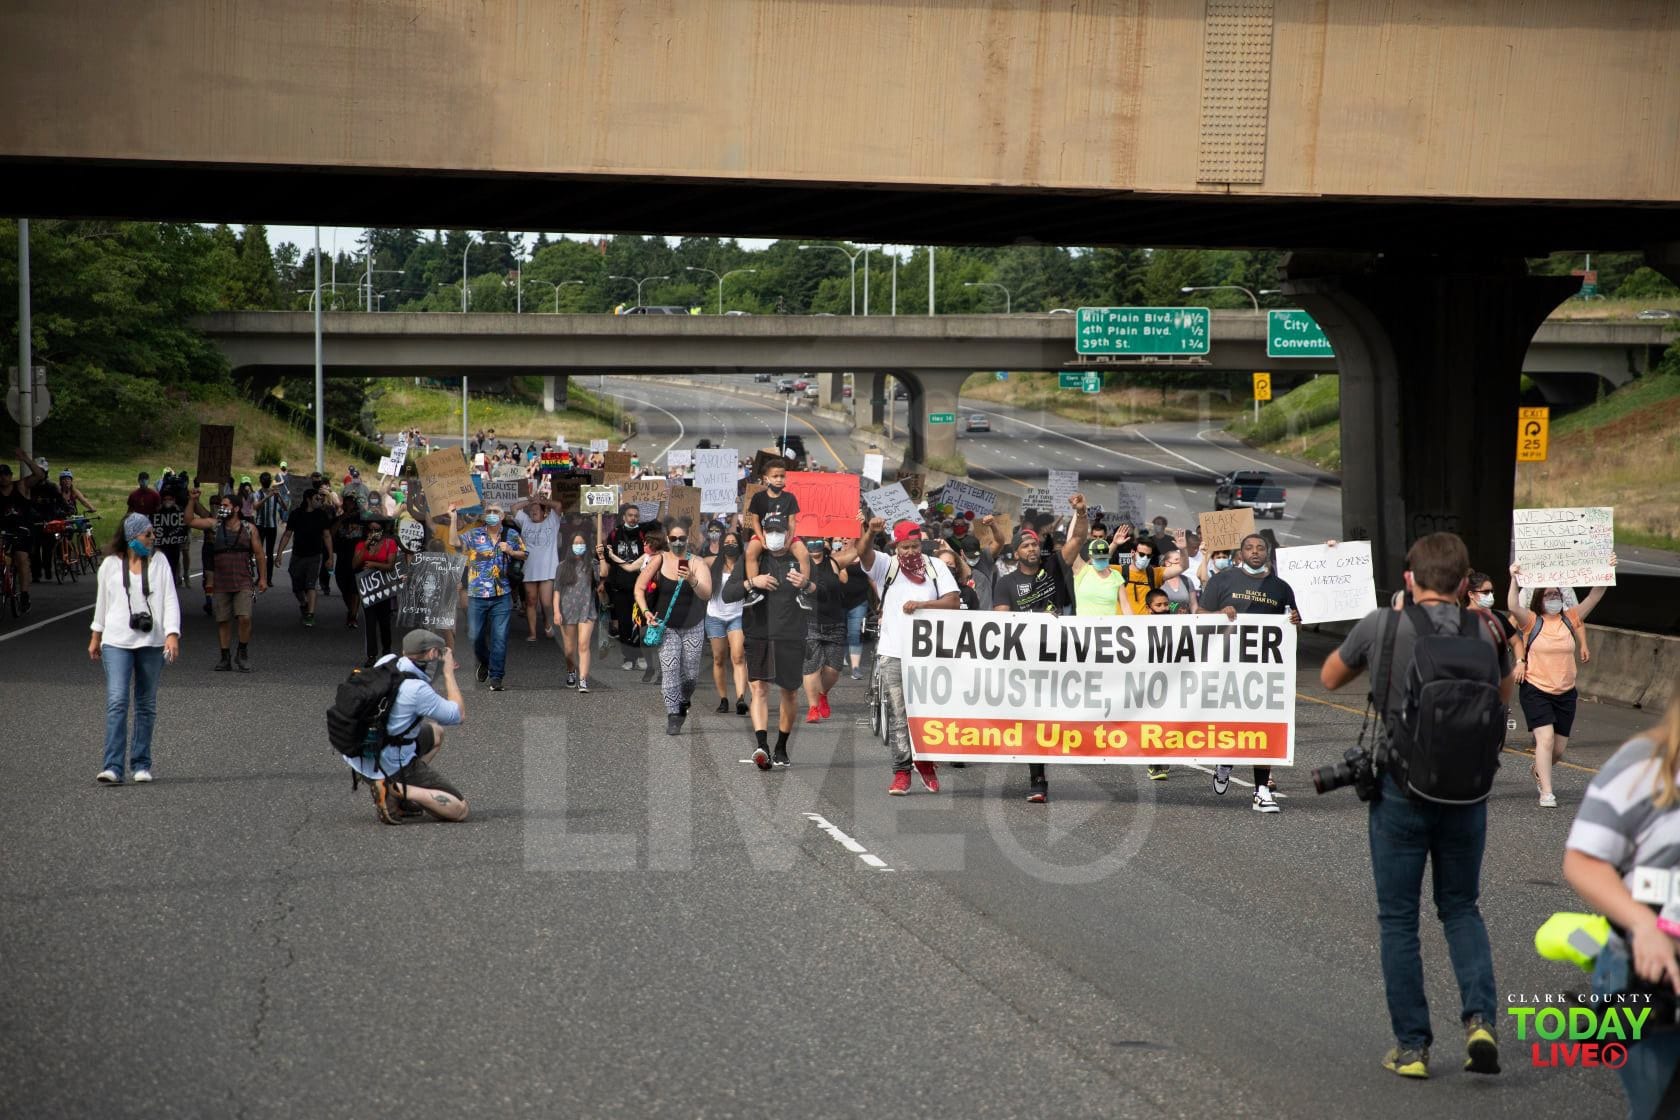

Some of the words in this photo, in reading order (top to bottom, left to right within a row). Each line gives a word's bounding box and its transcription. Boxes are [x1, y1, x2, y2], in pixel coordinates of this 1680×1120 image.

[1082, 312, 1104, 323] Mill
[1109, 313, 1140, 323] Plain
[1144, 312, 1173, 323] Blvd.
[1082, 325, 1103, 335] 4th
[1107, 326, 1138, 335] Plain
[1143, 326, 1171, 336] Blvd.
[1284, 320, 1309, 332] City
[1082, 338, 1109, 348] 39th
[1115, 339, 1130, 348] St.
[1523, 409, 1544, 418] EXIT
[1523, 440, 1541, 450] 25
[700, 454, 736, 468] ABOLISH
[702, 473, 730, 485] WHITE
[624, 481, 659, 492] DEFUND
[946, 480, 997, 504] JUNETEENTH
[701, 489, 737, 504] PREMACY
[1517, 511, 1541, 522] WE
[1518, 525, 1556, 537] NEVER
[1206, 534, 1242, 548] MATTE
[1519, 540, 1538, 550] WE
[431, 561, 461, 575] Taylor
[360, 562, 403, 595] JUSTICE
[1231, 592, 1251, 600] BETTER
[1252, 595, 1266, 603] THAN
[911, 619, 1026, 661] BLACK
[1038, 623, 1136, 664] LIVES
[1147, 625, 1284, 664] MATTER
[907, 665, 953, 706] NO
[963, 668, 1113, 718] JUSTICE,
[1123, 671, 1168, 709] NO
[1181, 671, 1286, 711] PEACE
[922, 720, 1024, 748] Stand
[1036, 723, 1082, 753] Up
[1094, 724, 1128, 749] to
[1141, 724, 1268, 750] Racism
